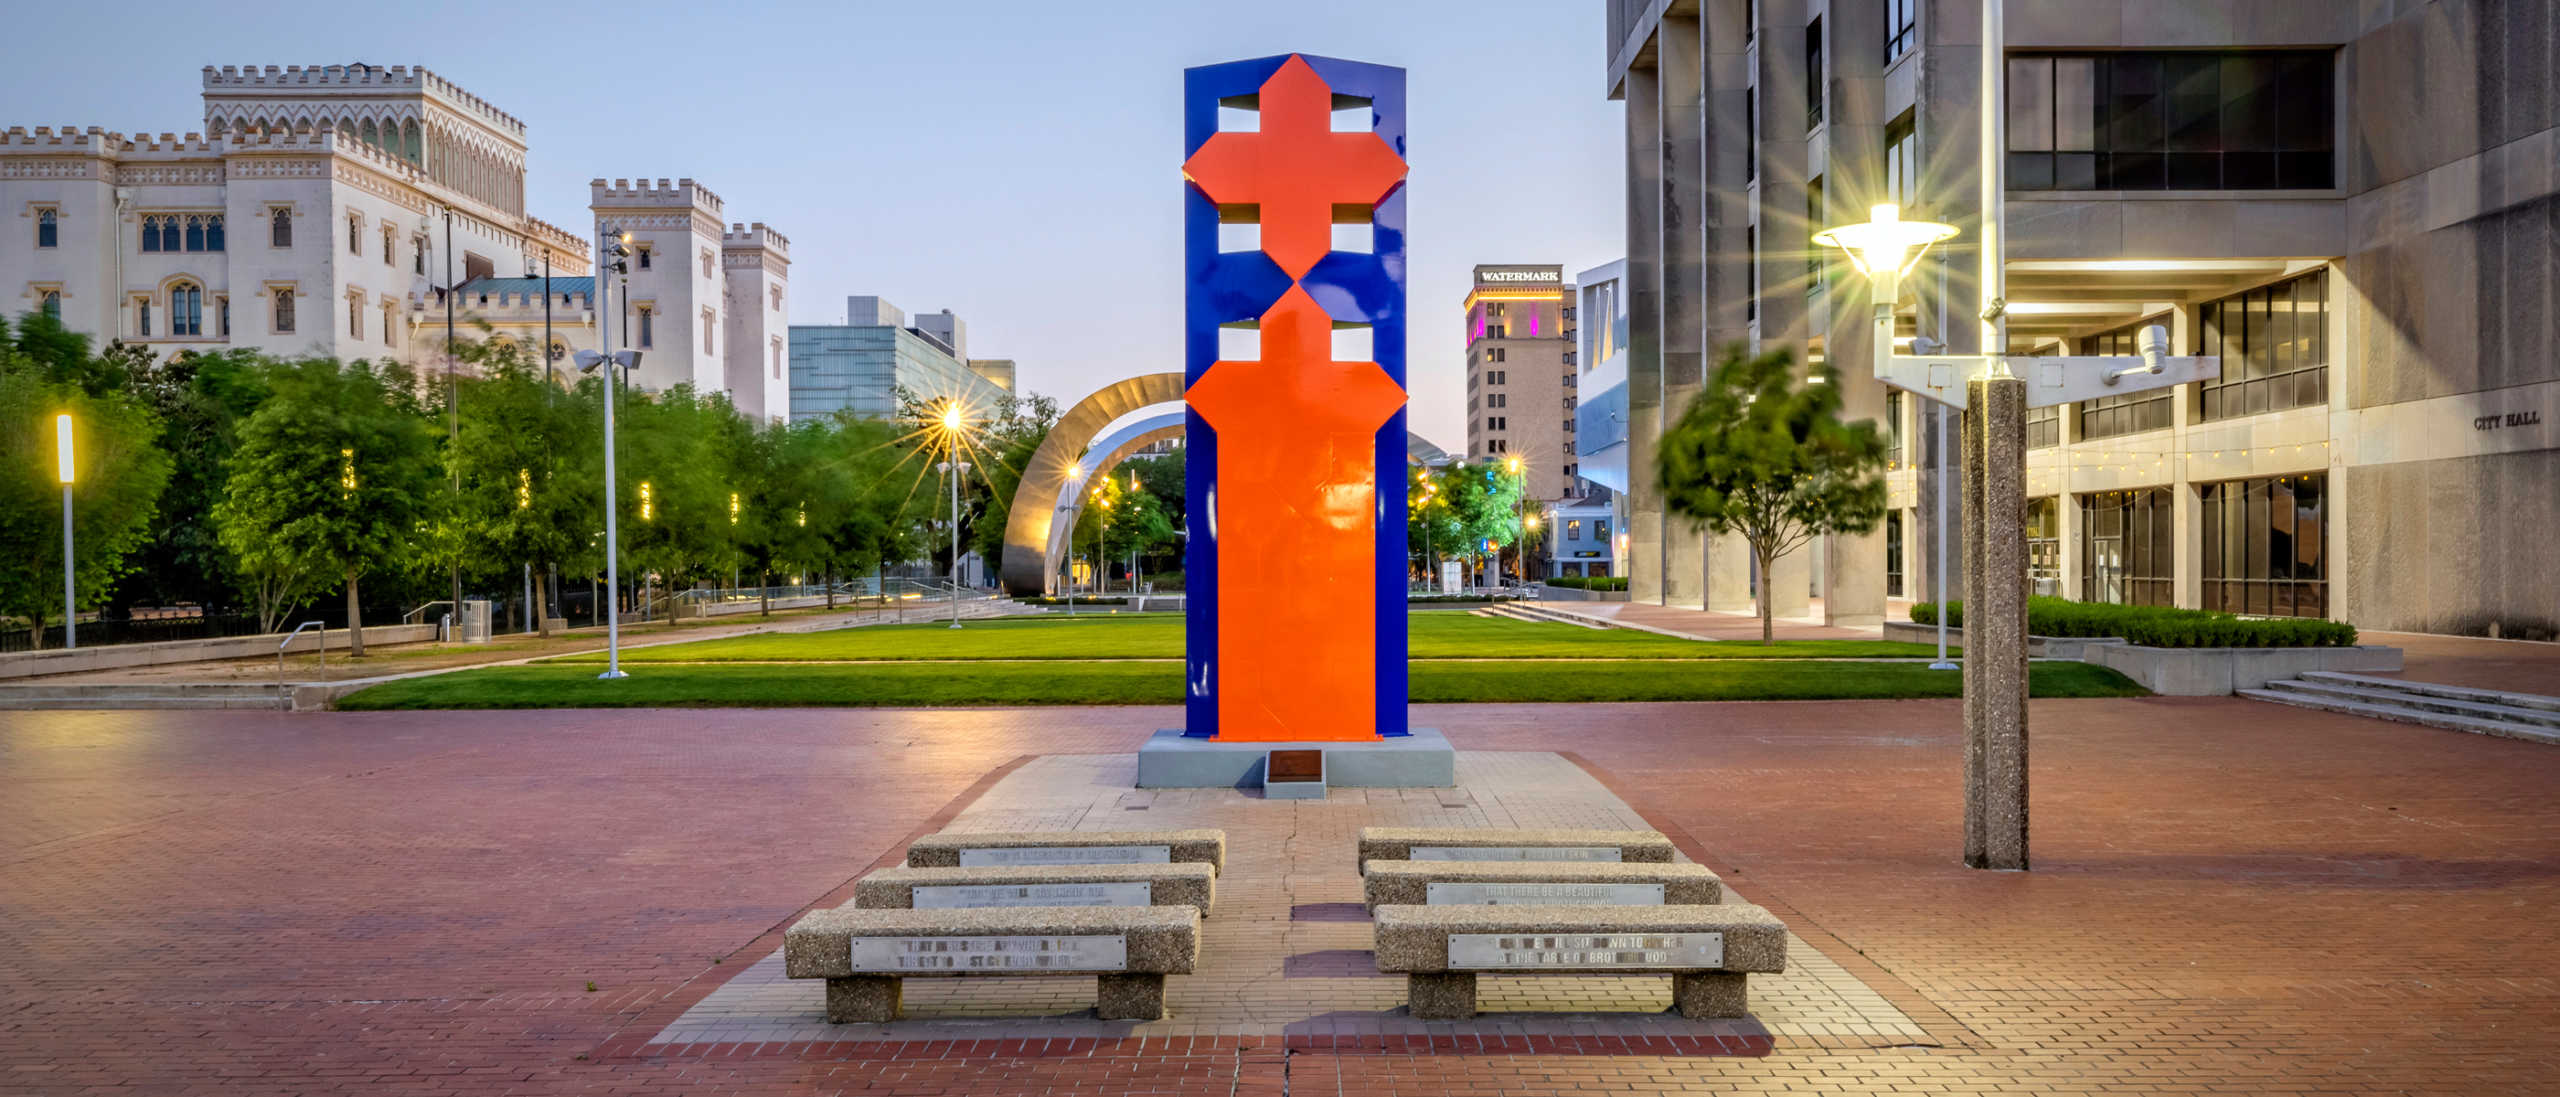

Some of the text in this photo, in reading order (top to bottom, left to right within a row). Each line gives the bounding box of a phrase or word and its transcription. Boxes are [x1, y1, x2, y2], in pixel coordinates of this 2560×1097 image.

[1481, 271, 1558, 281] WATERMARK
[2474, 411, 2540, 430] CITY HALL
